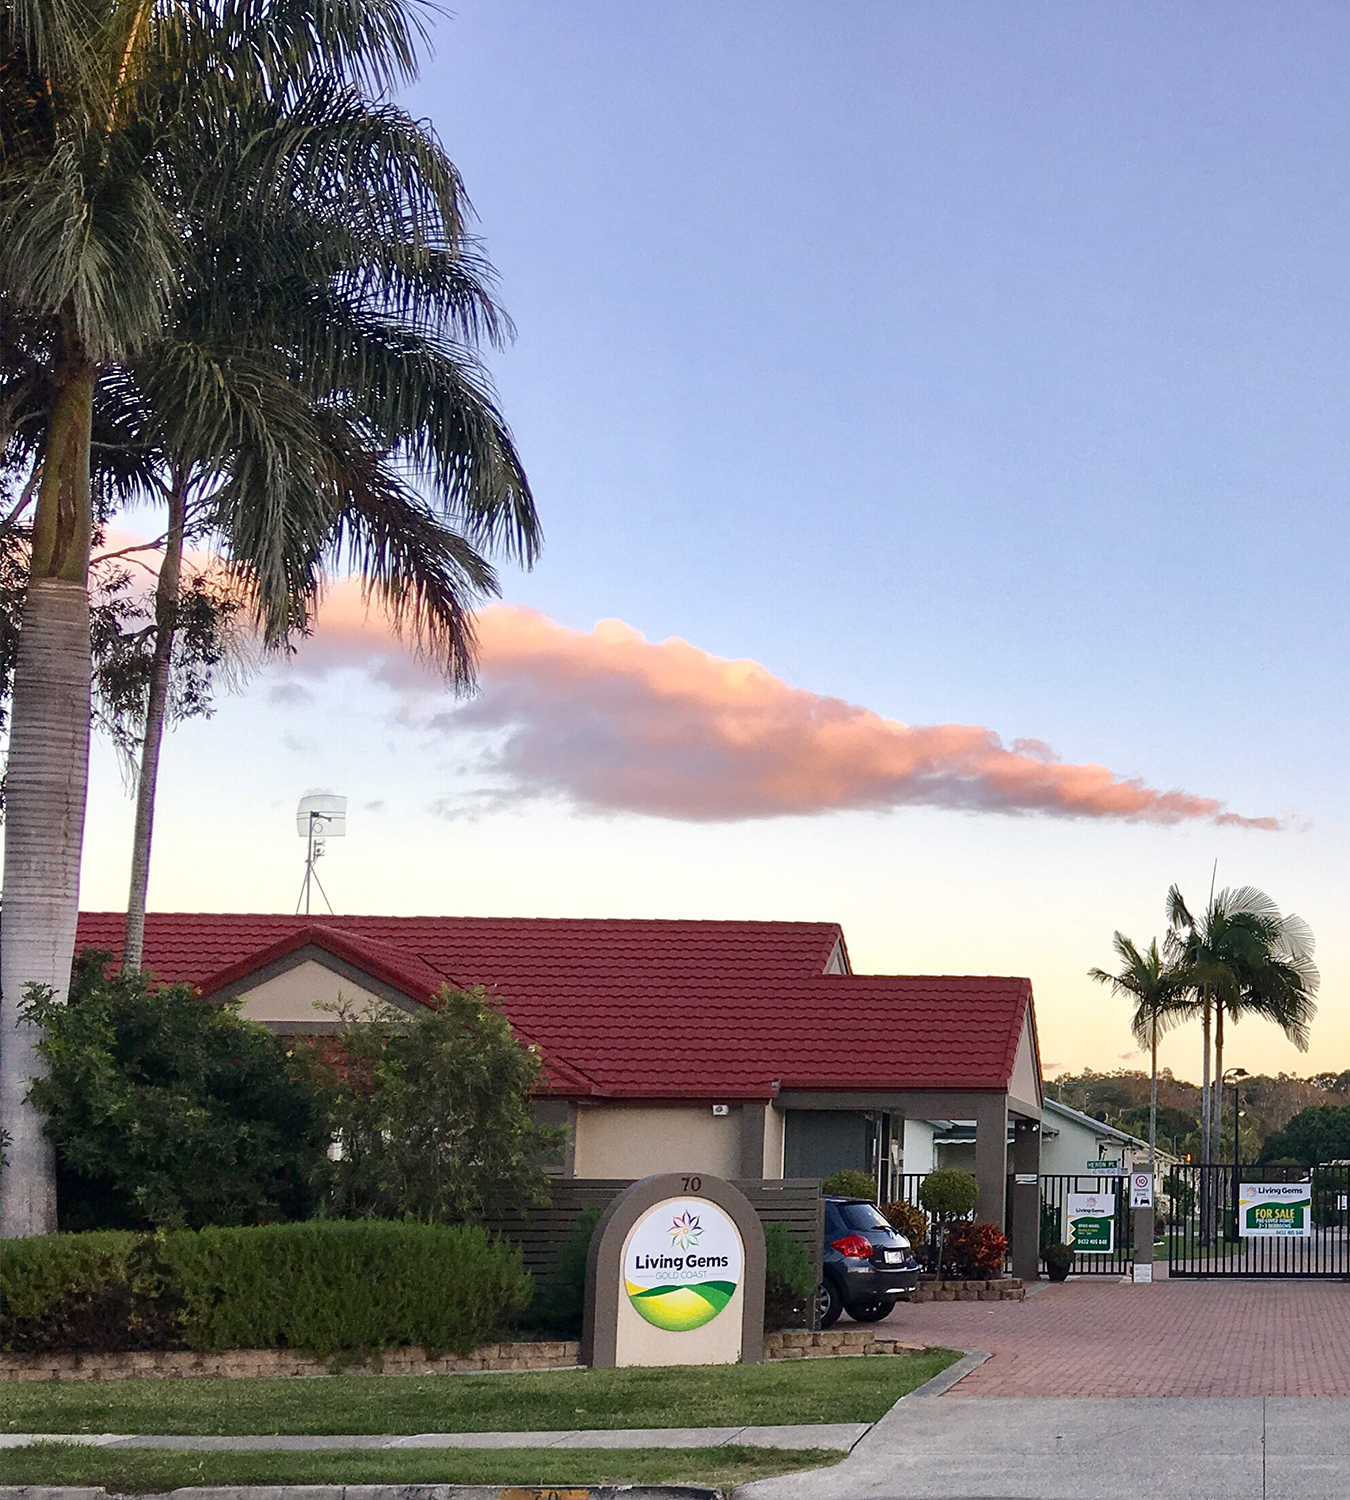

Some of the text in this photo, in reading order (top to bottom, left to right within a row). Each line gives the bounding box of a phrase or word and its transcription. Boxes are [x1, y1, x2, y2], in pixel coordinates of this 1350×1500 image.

[681, 1176, 702, 1192] 70
[1258, 1186, 1281, 1195] Living
[1255, 1208, 1295, 1219] FOR SALE
[635, 1253, 729, 1271] Living Gems
[655, 1270, 708, 1280] GOLD COAST
